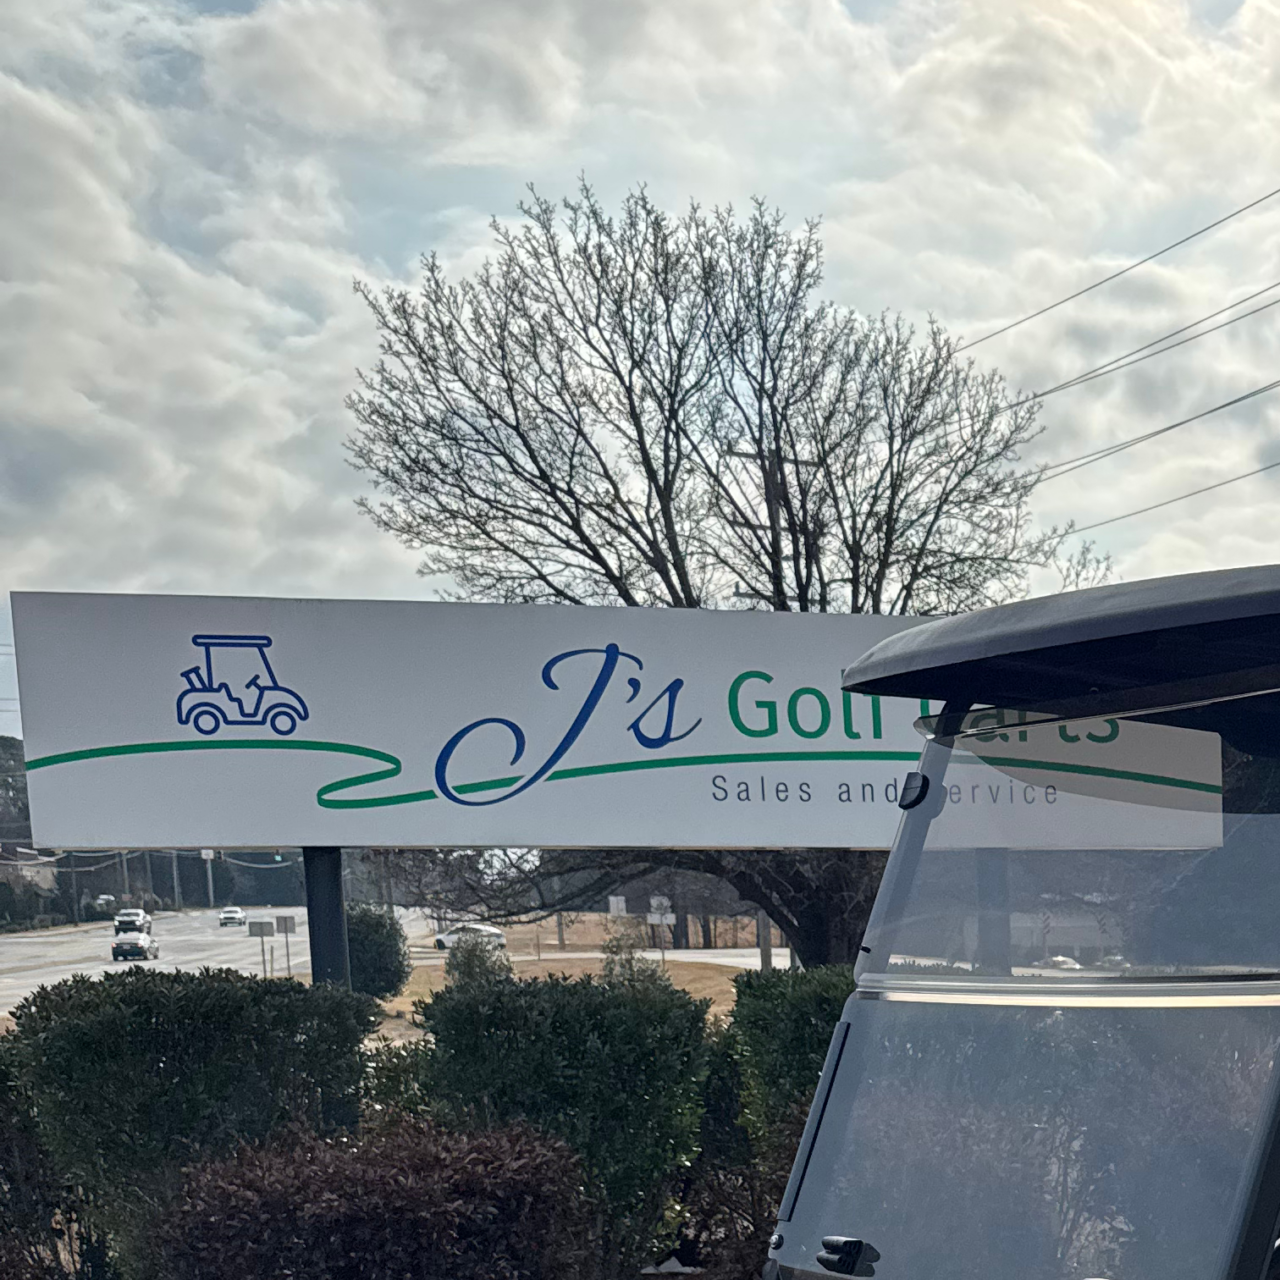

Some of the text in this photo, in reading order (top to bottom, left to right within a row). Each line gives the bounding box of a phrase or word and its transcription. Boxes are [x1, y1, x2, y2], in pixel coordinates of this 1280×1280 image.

[434, 642, 703, 807] J's
[711, 774, 1058, 805] Sales and ervice
